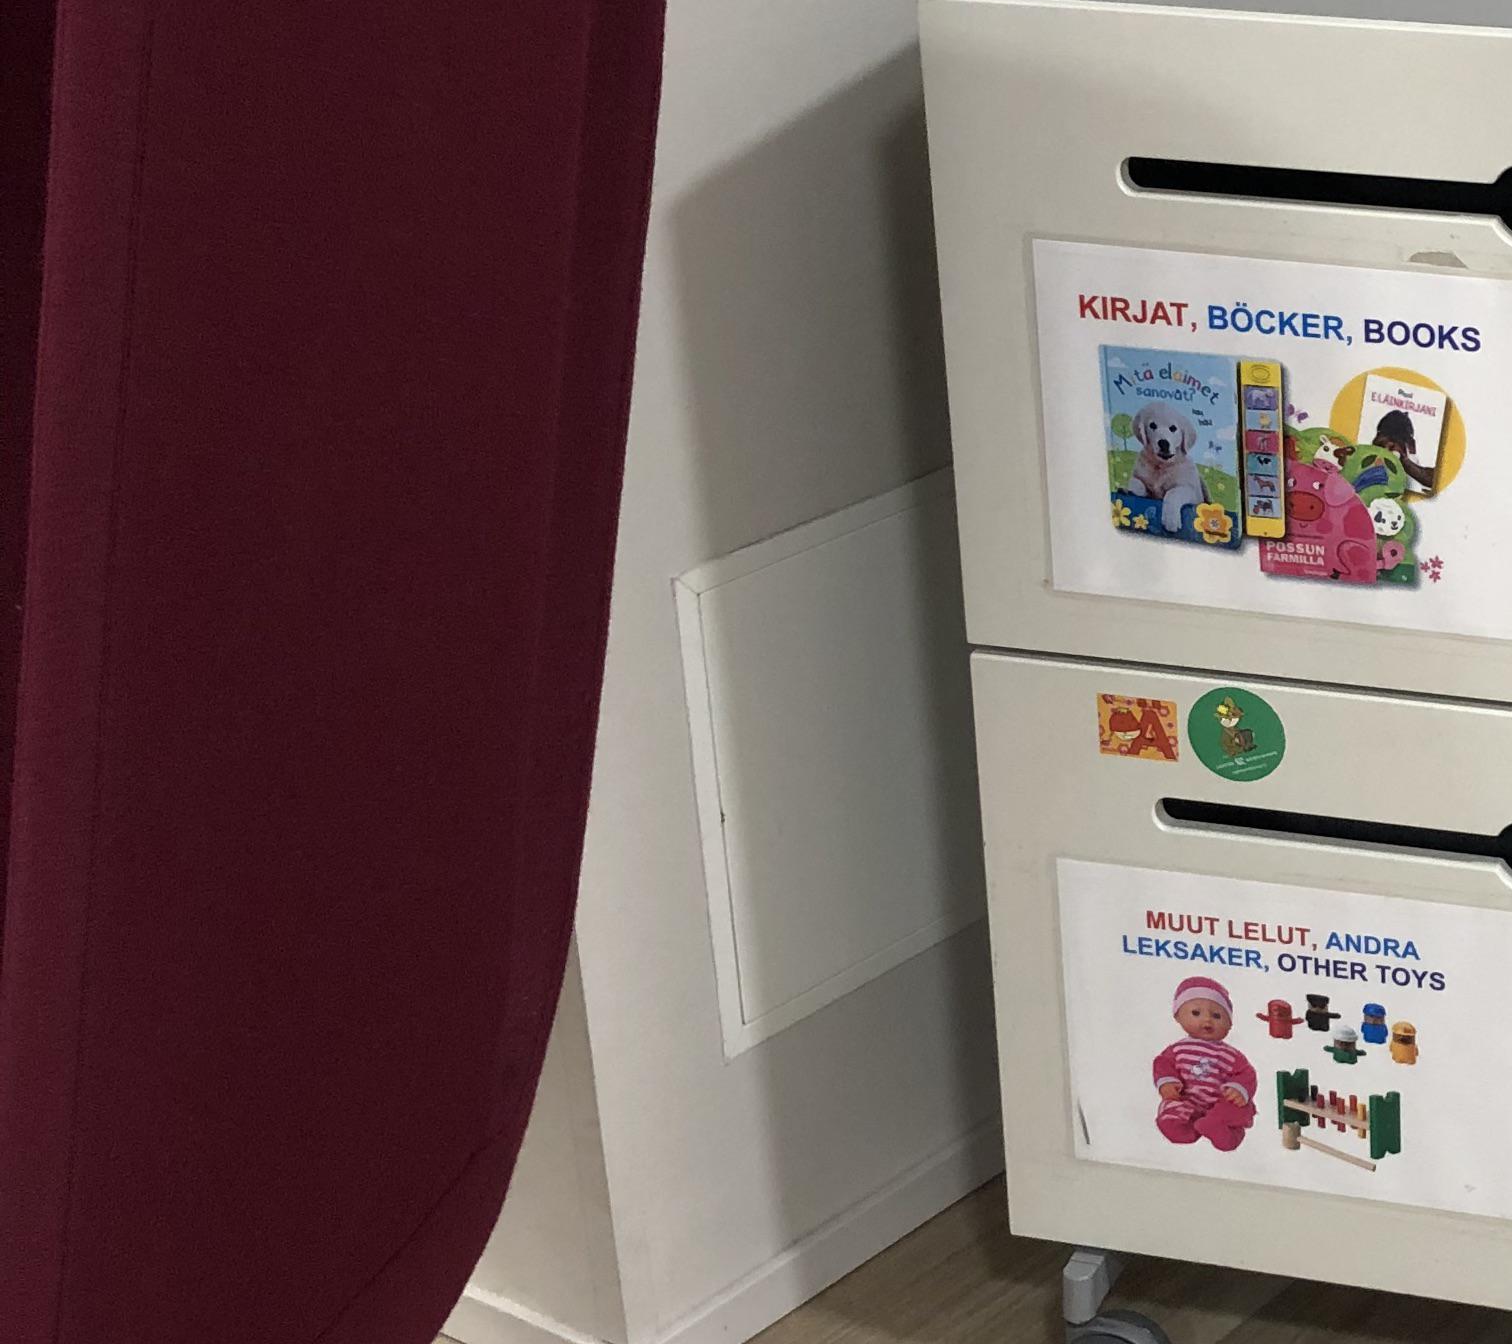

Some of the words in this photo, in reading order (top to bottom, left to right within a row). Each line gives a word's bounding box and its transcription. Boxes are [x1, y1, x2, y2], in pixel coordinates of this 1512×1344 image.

[1078, 293, 1198, 333] KIRJAT,
[1207, 301, 1353, 346] BÖCKER,
[1363, 318, 1481, 353] BOOKS
[1266, 540, 1325, 556] POSSUN
[1266, 552, 1325, 566] FARMILLA
[1146, 910, 1220, 937] MUUT
[1227, 919, 1318, 952] LELUT,
[1325, 931, 1421, 961] ANDRA
[1122, 934, 1270, 973] LEKSAKER,
[1277, 952, 1369, 982] OTHER
[1375, 964, 1446, 992] TOYS
